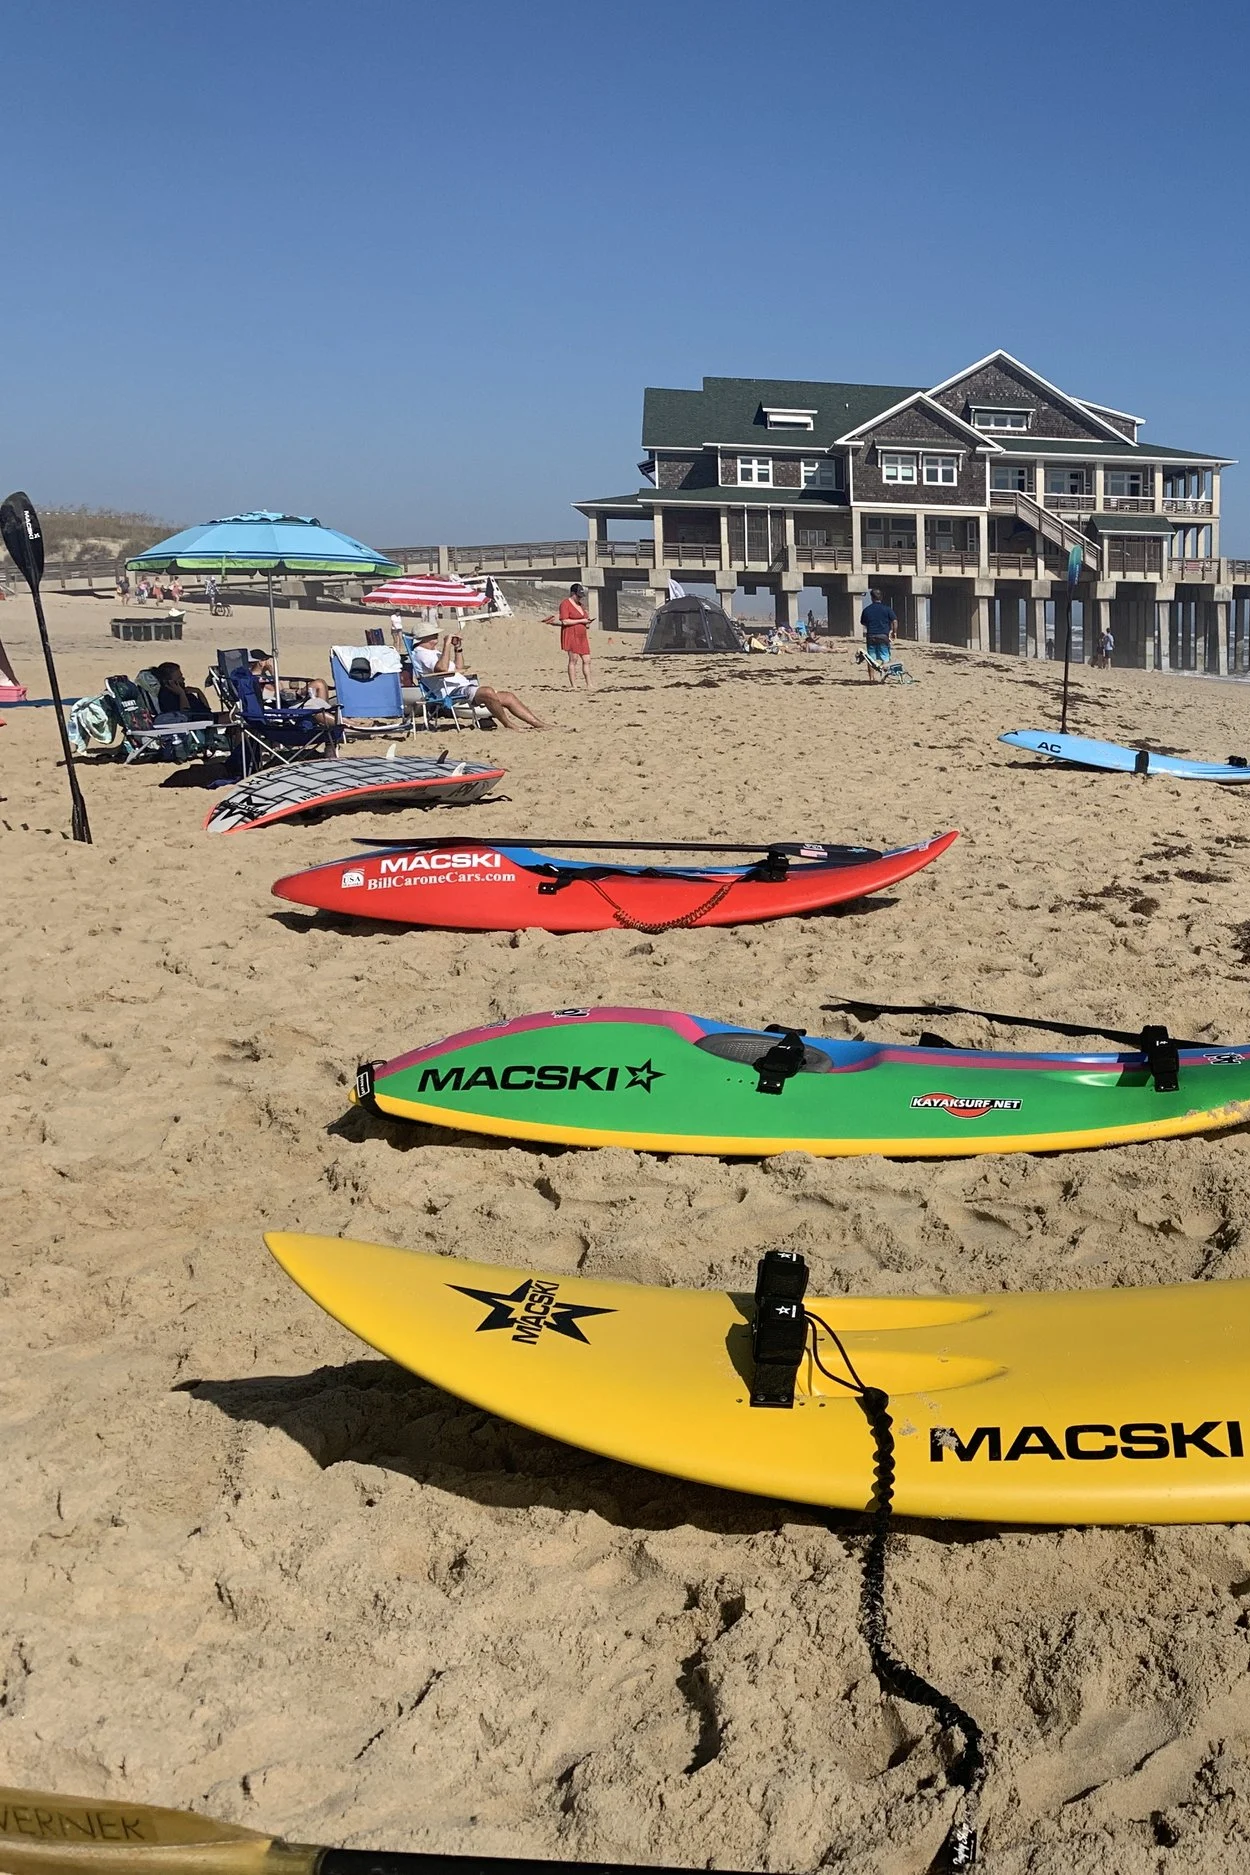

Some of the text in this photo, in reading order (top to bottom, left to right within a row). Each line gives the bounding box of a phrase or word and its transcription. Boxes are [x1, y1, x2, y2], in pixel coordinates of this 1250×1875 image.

[1037, 741, 1062, 753] AC
[380, 853, 501, 873] MACSKI
[343, 876, 361, 884] USA
[367, 871, 516, 890] BillCaroneCars.com
[417, 1065, 620, 1092] MACSKI
[912, 1098, 1020, 1109] KAYAKSURF.NET
[511, 1279, 560, 1345] MACSKI
[929, 1420, 1244, 1462] MACSKI
